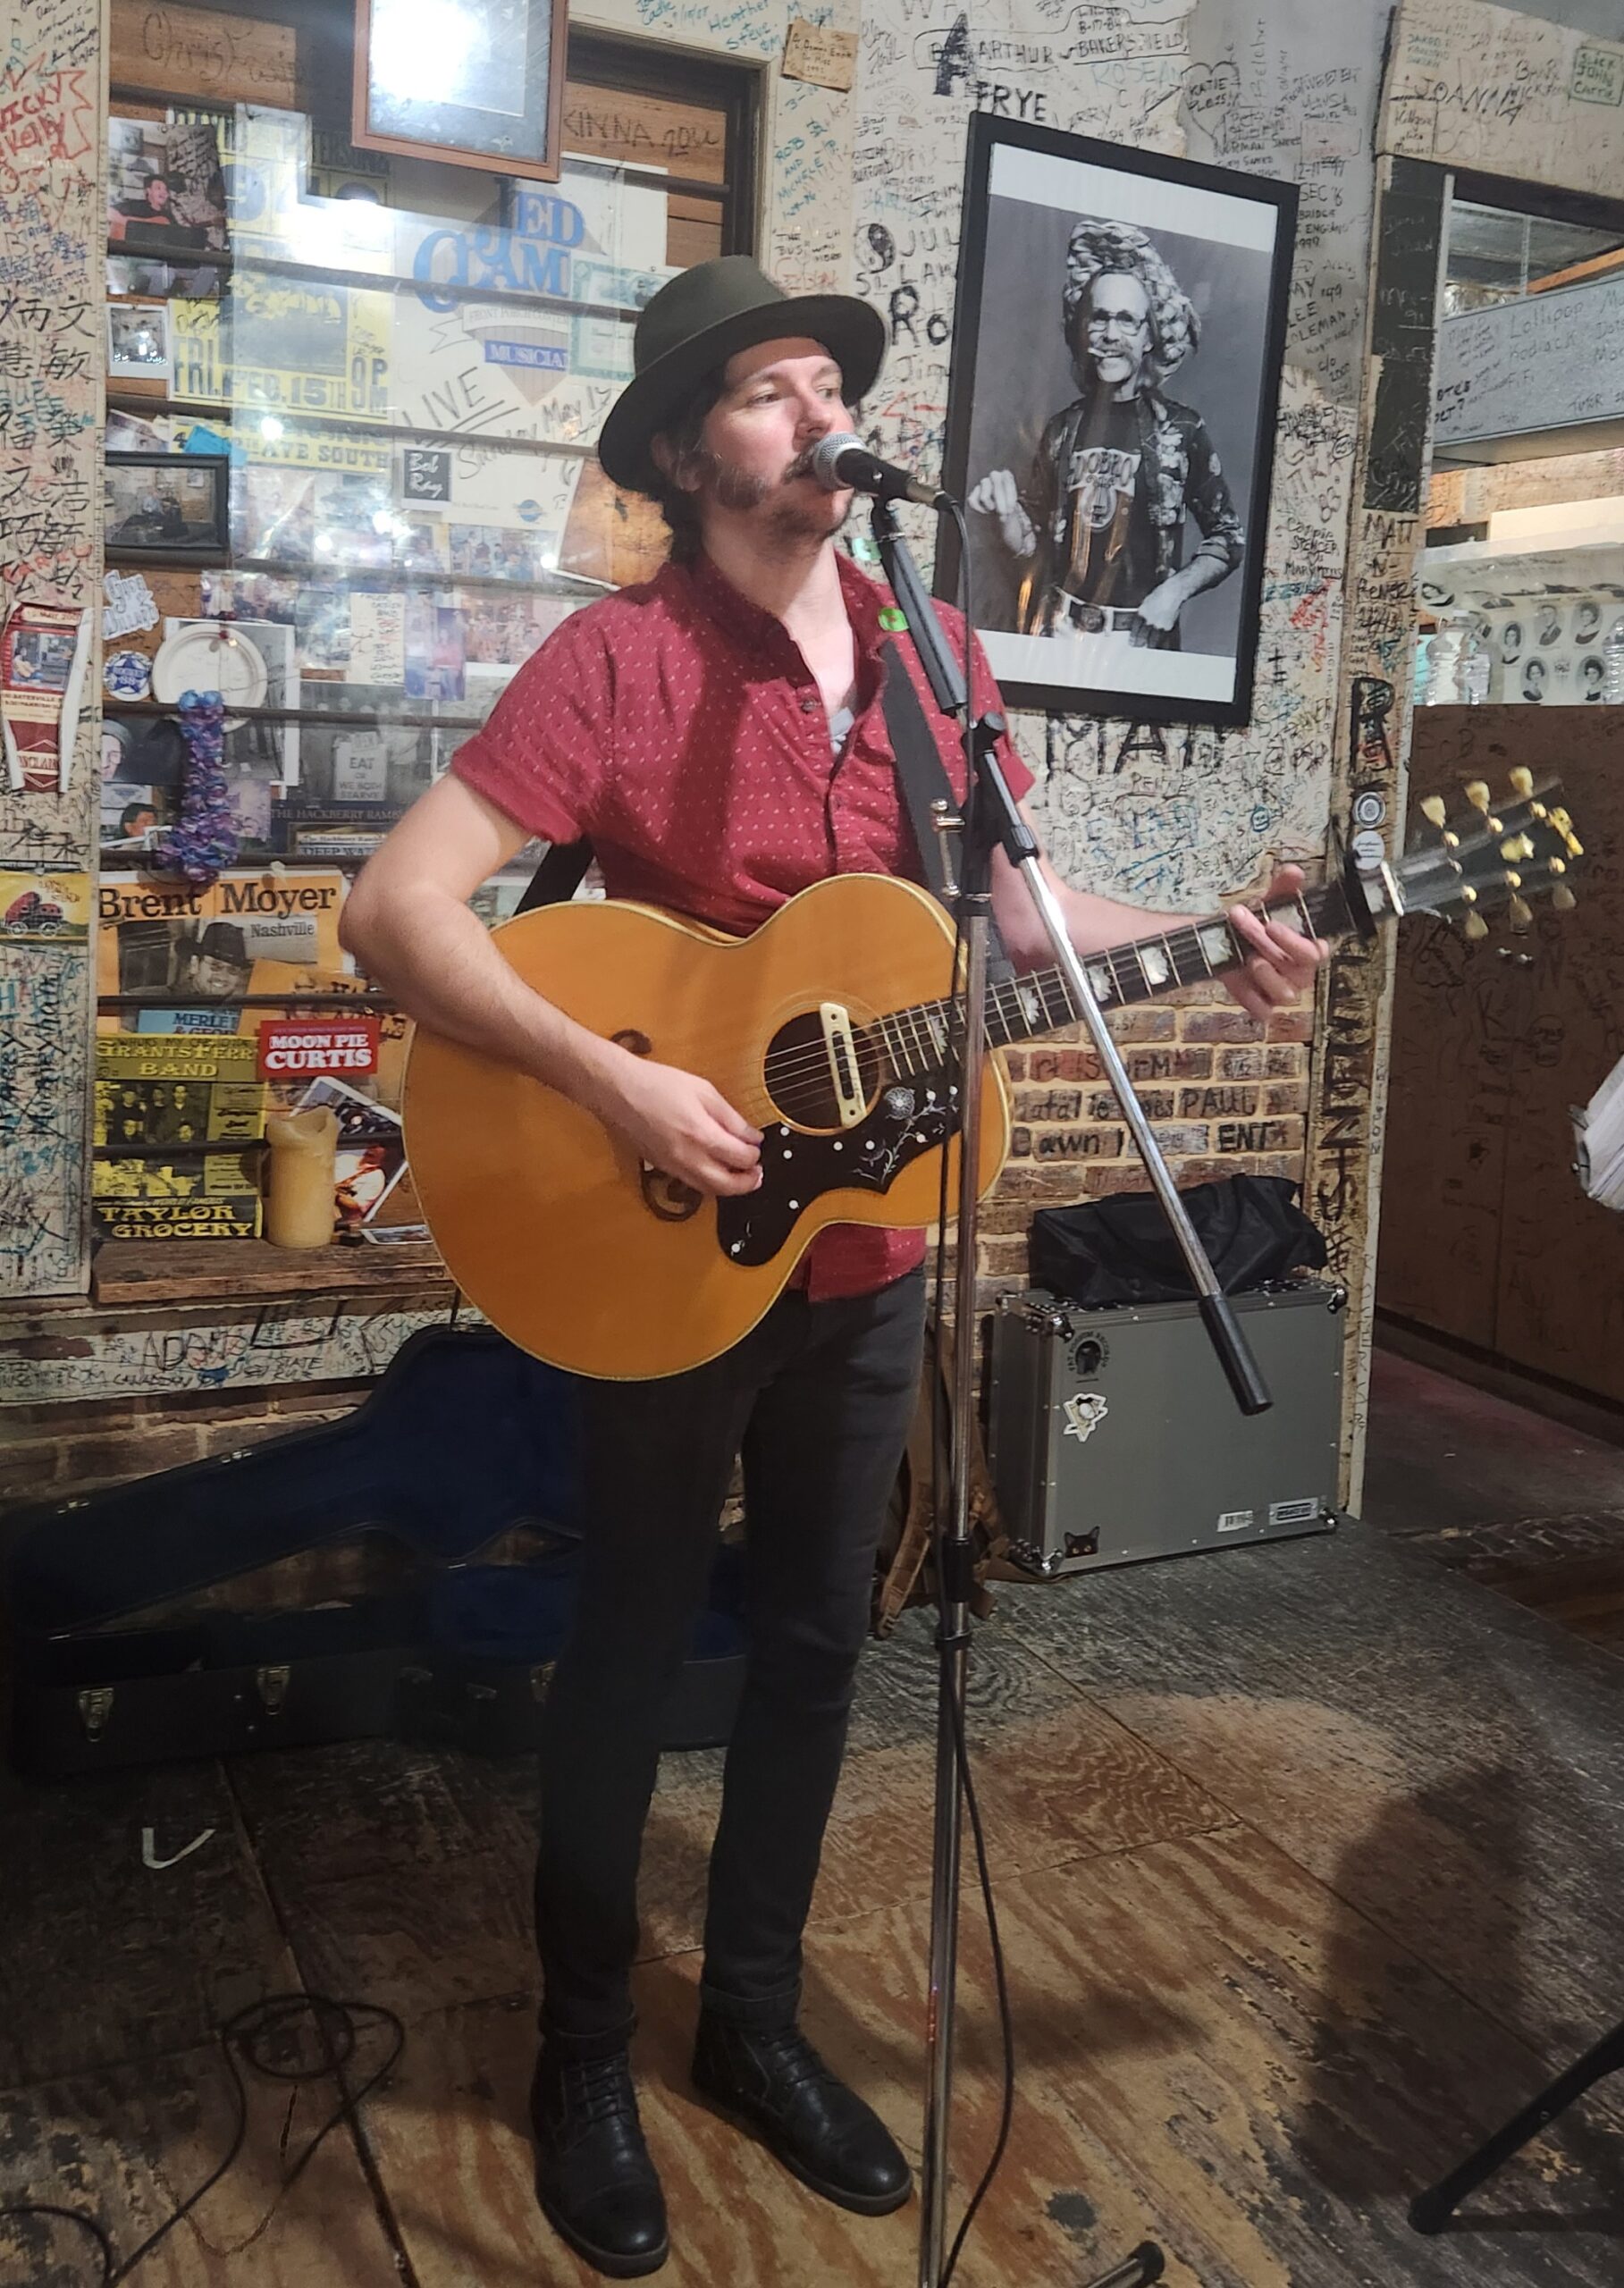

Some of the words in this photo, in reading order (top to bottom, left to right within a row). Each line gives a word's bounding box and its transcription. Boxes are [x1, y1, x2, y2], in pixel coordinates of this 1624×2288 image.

[972, 80, 1048, 122] FRYE
[317, 443, 391, 468] SOUTH
[349, 756, 375, 770] EAT
[99, 887, 202, 919] Brent
[220, 881, 336, 919] Moyer
[250, 923, 315, 938] Nashville
[269, 1034, 332, 1049] MOON
[334, 1033, 369, 1047] PIE
[265, 1048, 372, 1070] CURTIS
[139, 1062, 219, 1078] BAND
[97, 1205, 236, 1223] TAYLOR
[111, 1222, 253, 1238] GROCERY
